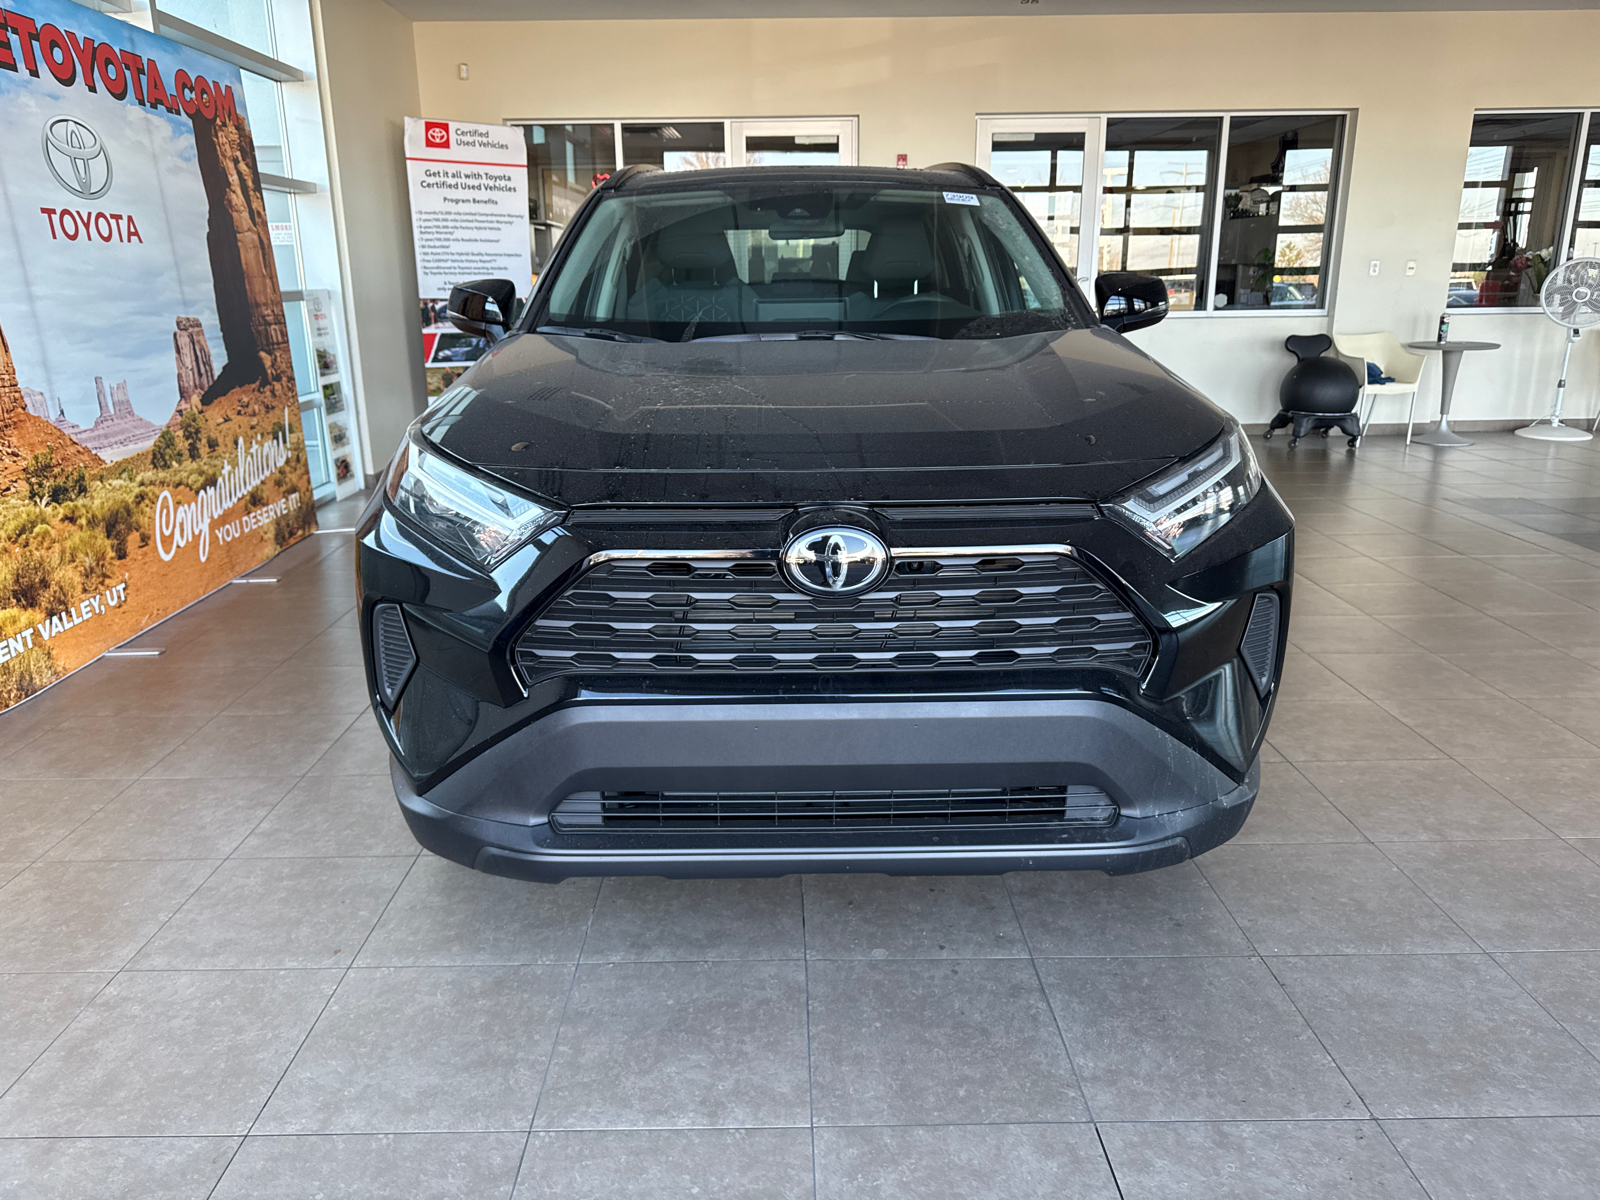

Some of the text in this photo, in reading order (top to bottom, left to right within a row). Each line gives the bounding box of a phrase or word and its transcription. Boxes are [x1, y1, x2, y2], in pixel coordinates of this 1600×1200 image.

[455, 128, 489, 138] Certified
[456, 138, 509, 150] Used Vehicles
[424, 169, 512, 182] Get it all with Toyota
[420, 180, 517, 193] Certified Used Vehicles
[443, 196, 498, 206] Program Benefits
[40, 207, 143, 244] TOYOTA
[155, 406, 292, 562] Congratulations!
[215, 492, 301, 545] YOU DESERVE IT!
[0, 582, 126, 664] ENT VALLEY, UT
